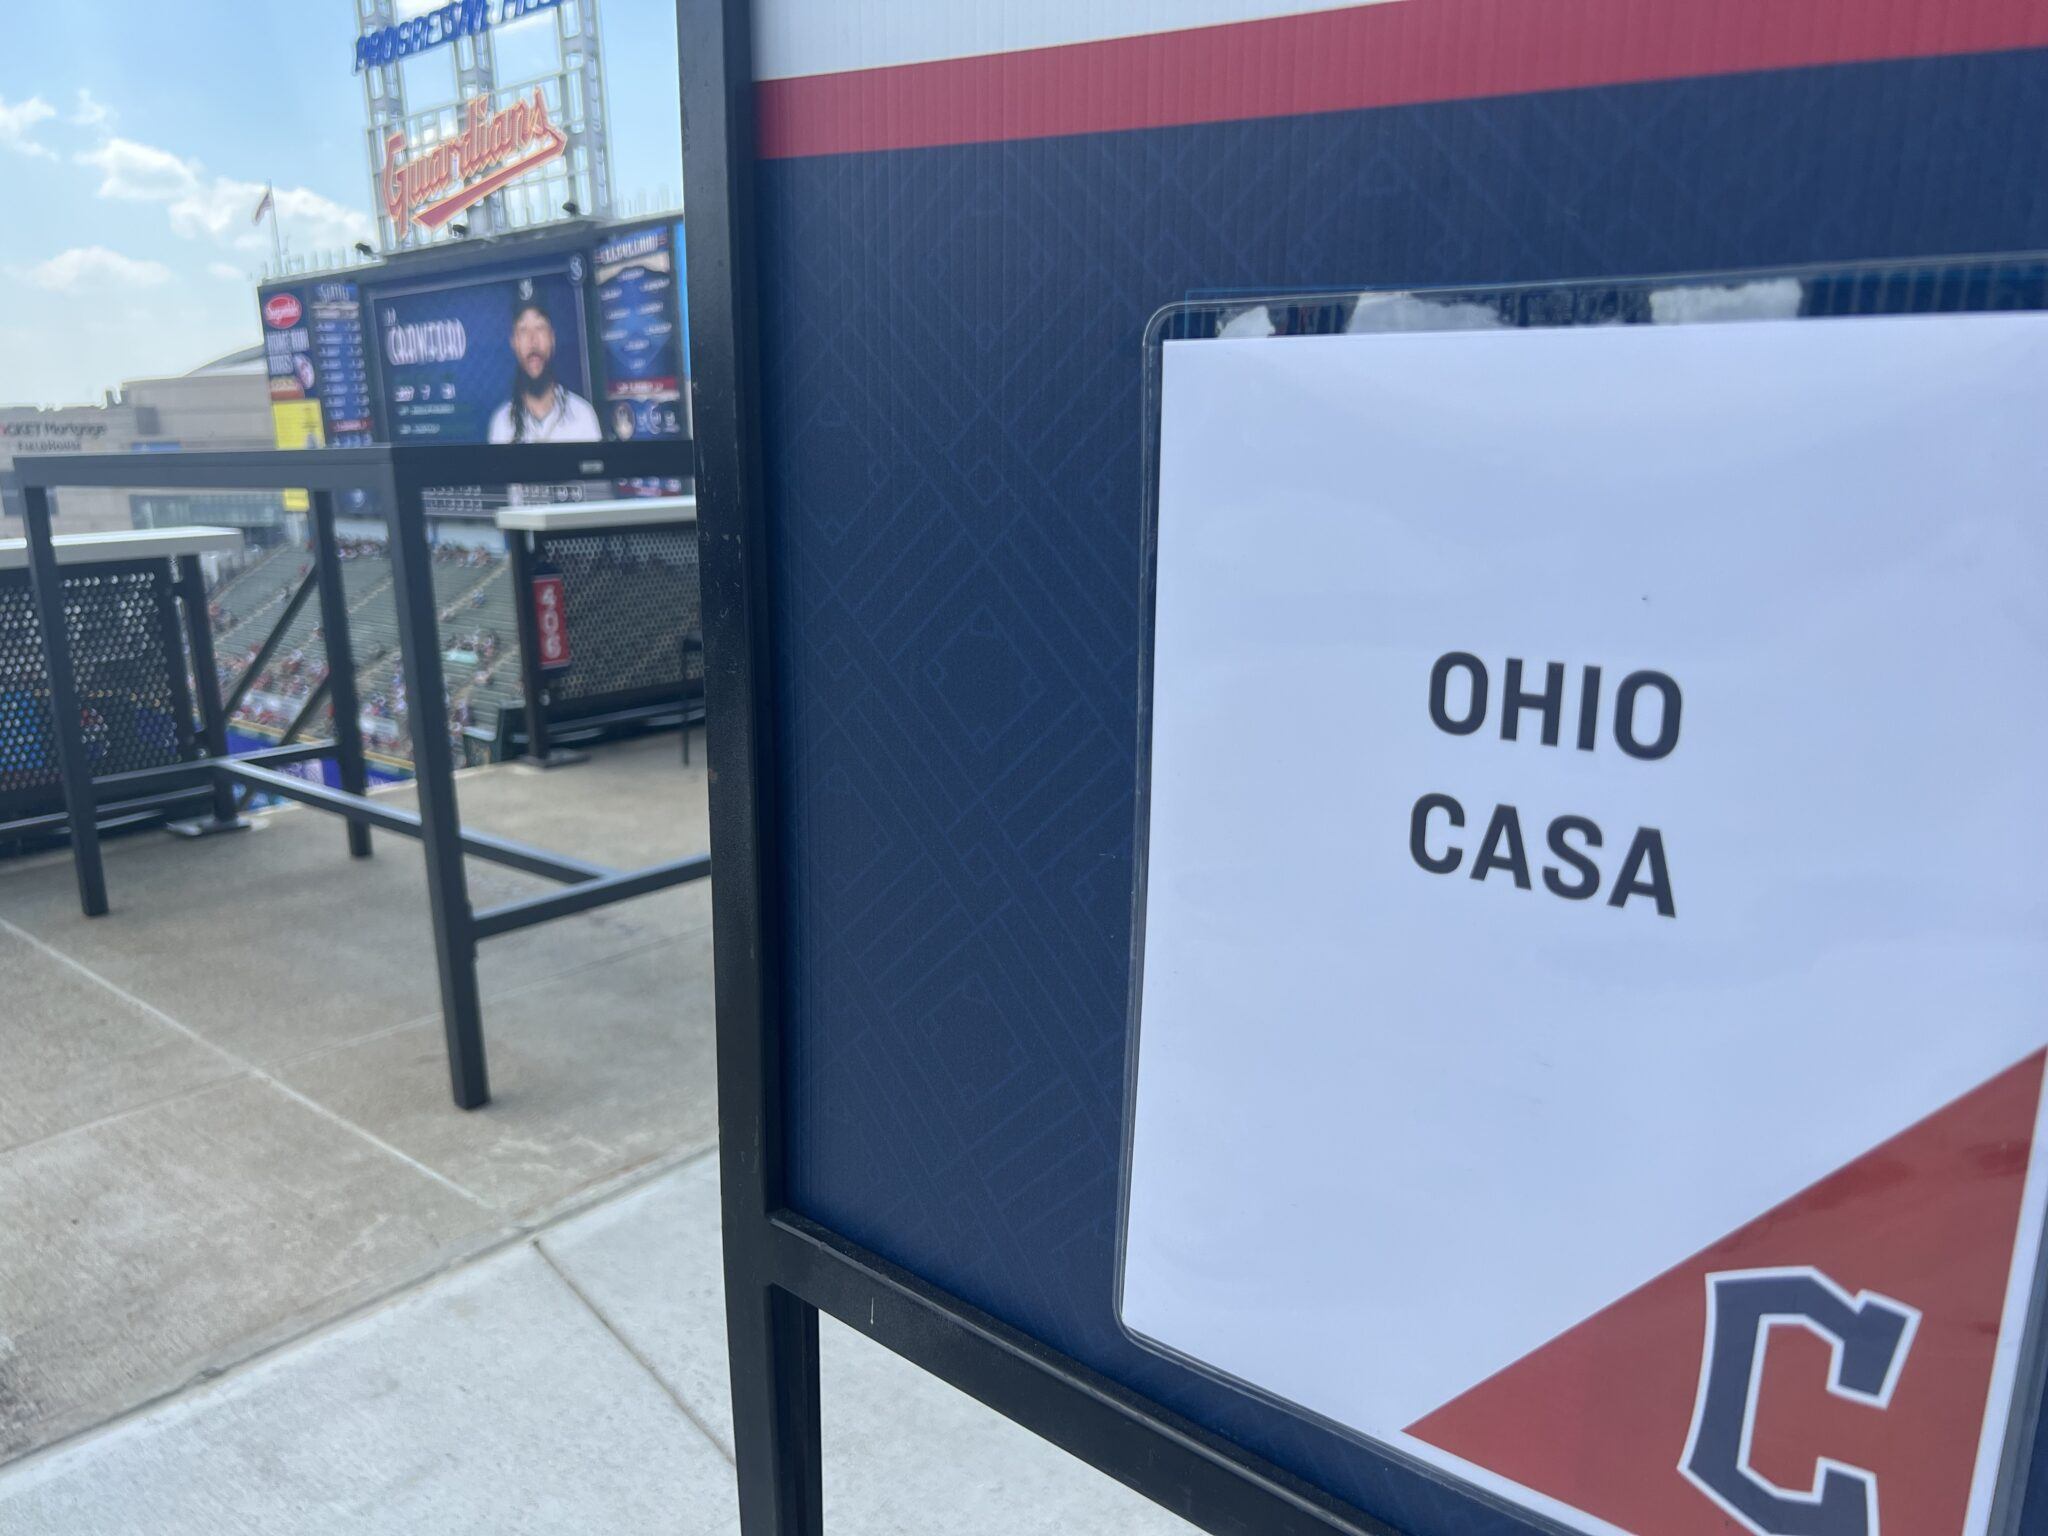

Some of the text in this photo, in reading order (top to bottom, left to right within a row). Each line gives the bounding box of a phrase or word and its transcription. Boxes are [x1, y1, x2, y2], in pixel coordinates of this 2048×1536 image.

[383, 86, 567, 239] Guardians
[539, 585, 562, 660] 406
[1428, 650, 1685, 761] OHIO
[1409, 793, 1678, 918] CASA
[1677, 1265, 1922, 1536] C
